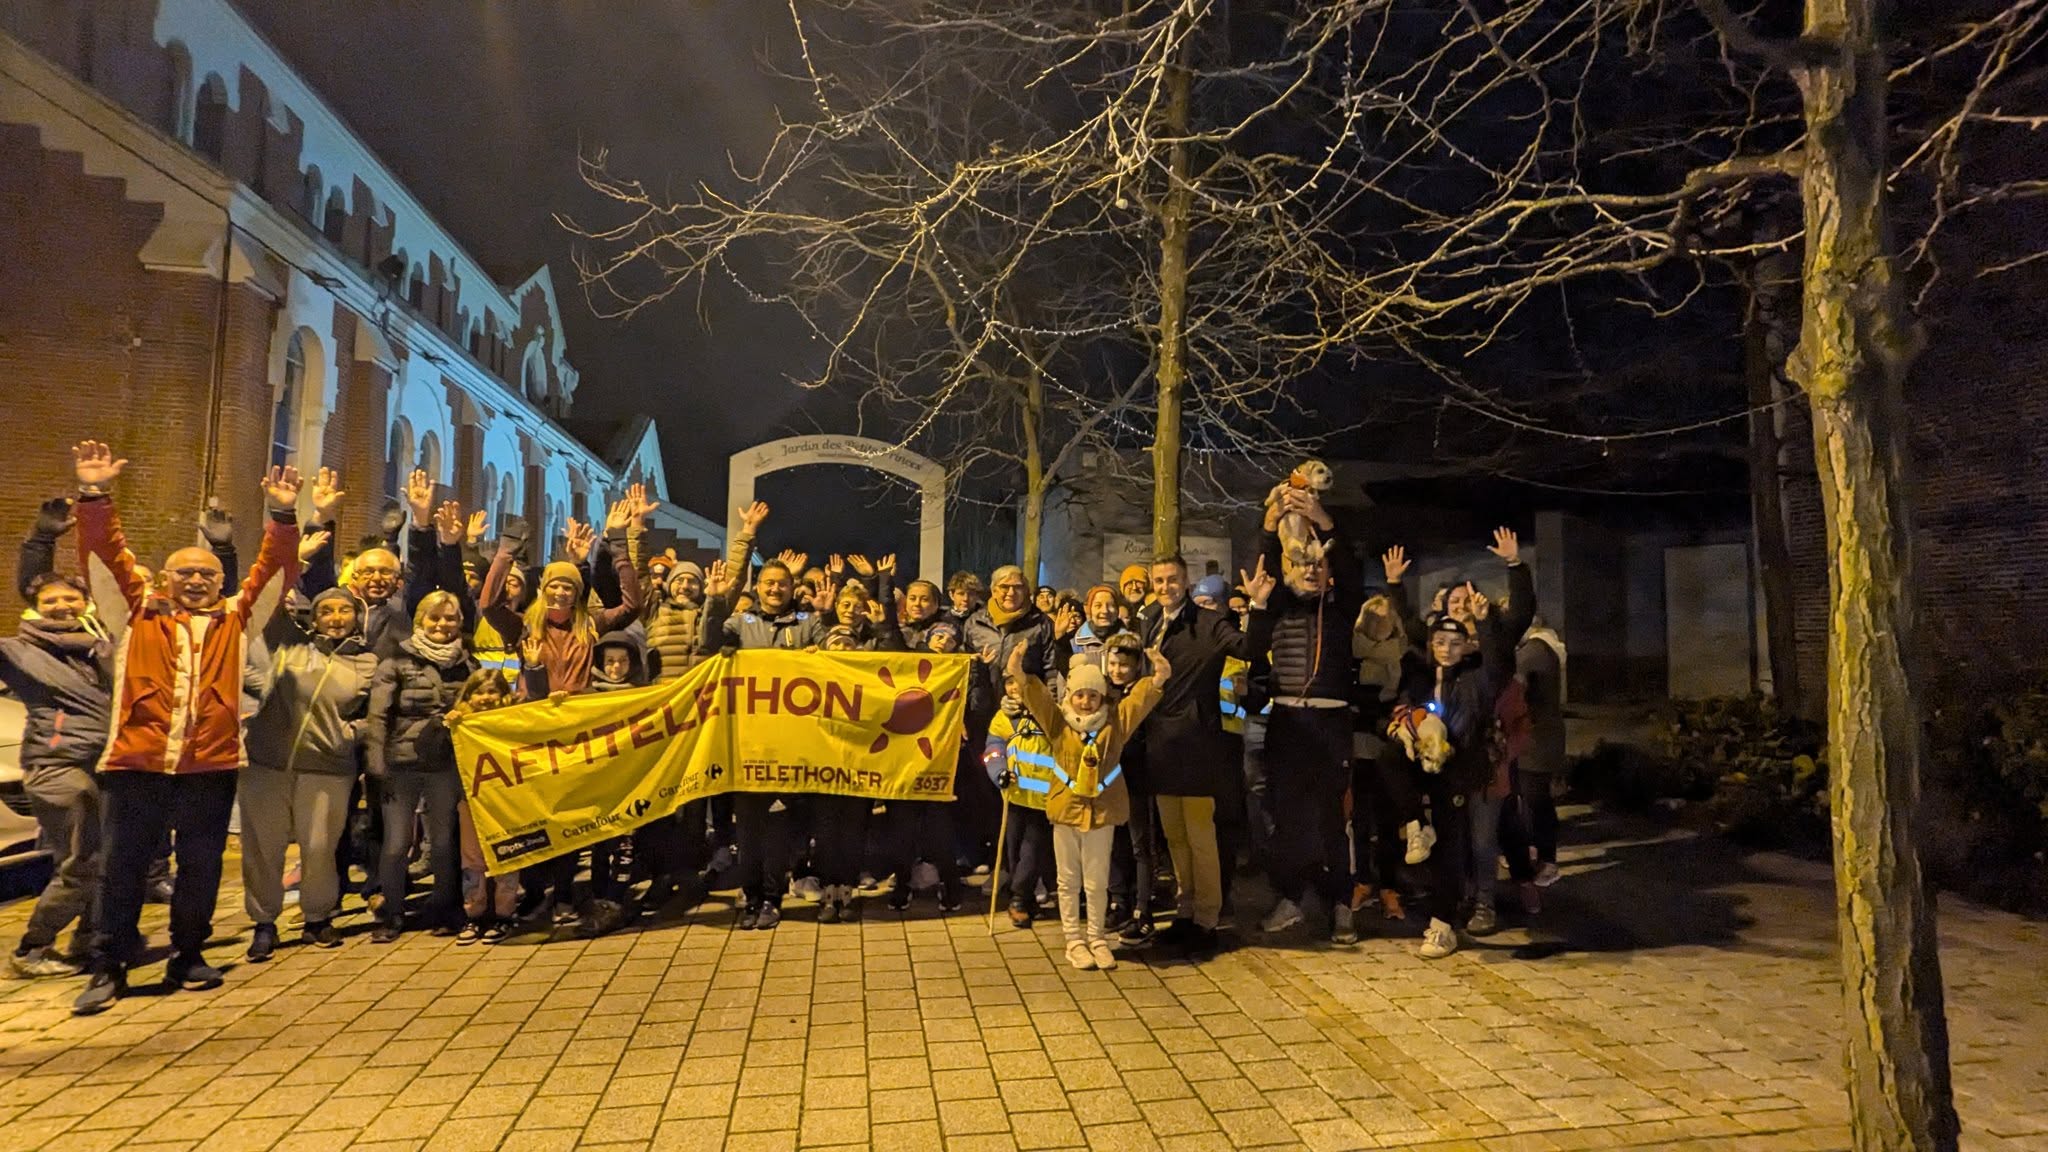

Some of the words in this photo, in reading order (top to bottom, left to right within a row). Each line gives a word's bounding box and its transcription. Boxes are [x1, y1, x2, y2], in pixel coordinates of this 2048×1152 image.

[781, 440, 819, 456] Jardin
[822, 439, 842, 450] des
[743, 764, 883, 788] TELETHON.FR
[913, 775, 950, 791] 3637
[562, 810, 622, 839] Carrefour
